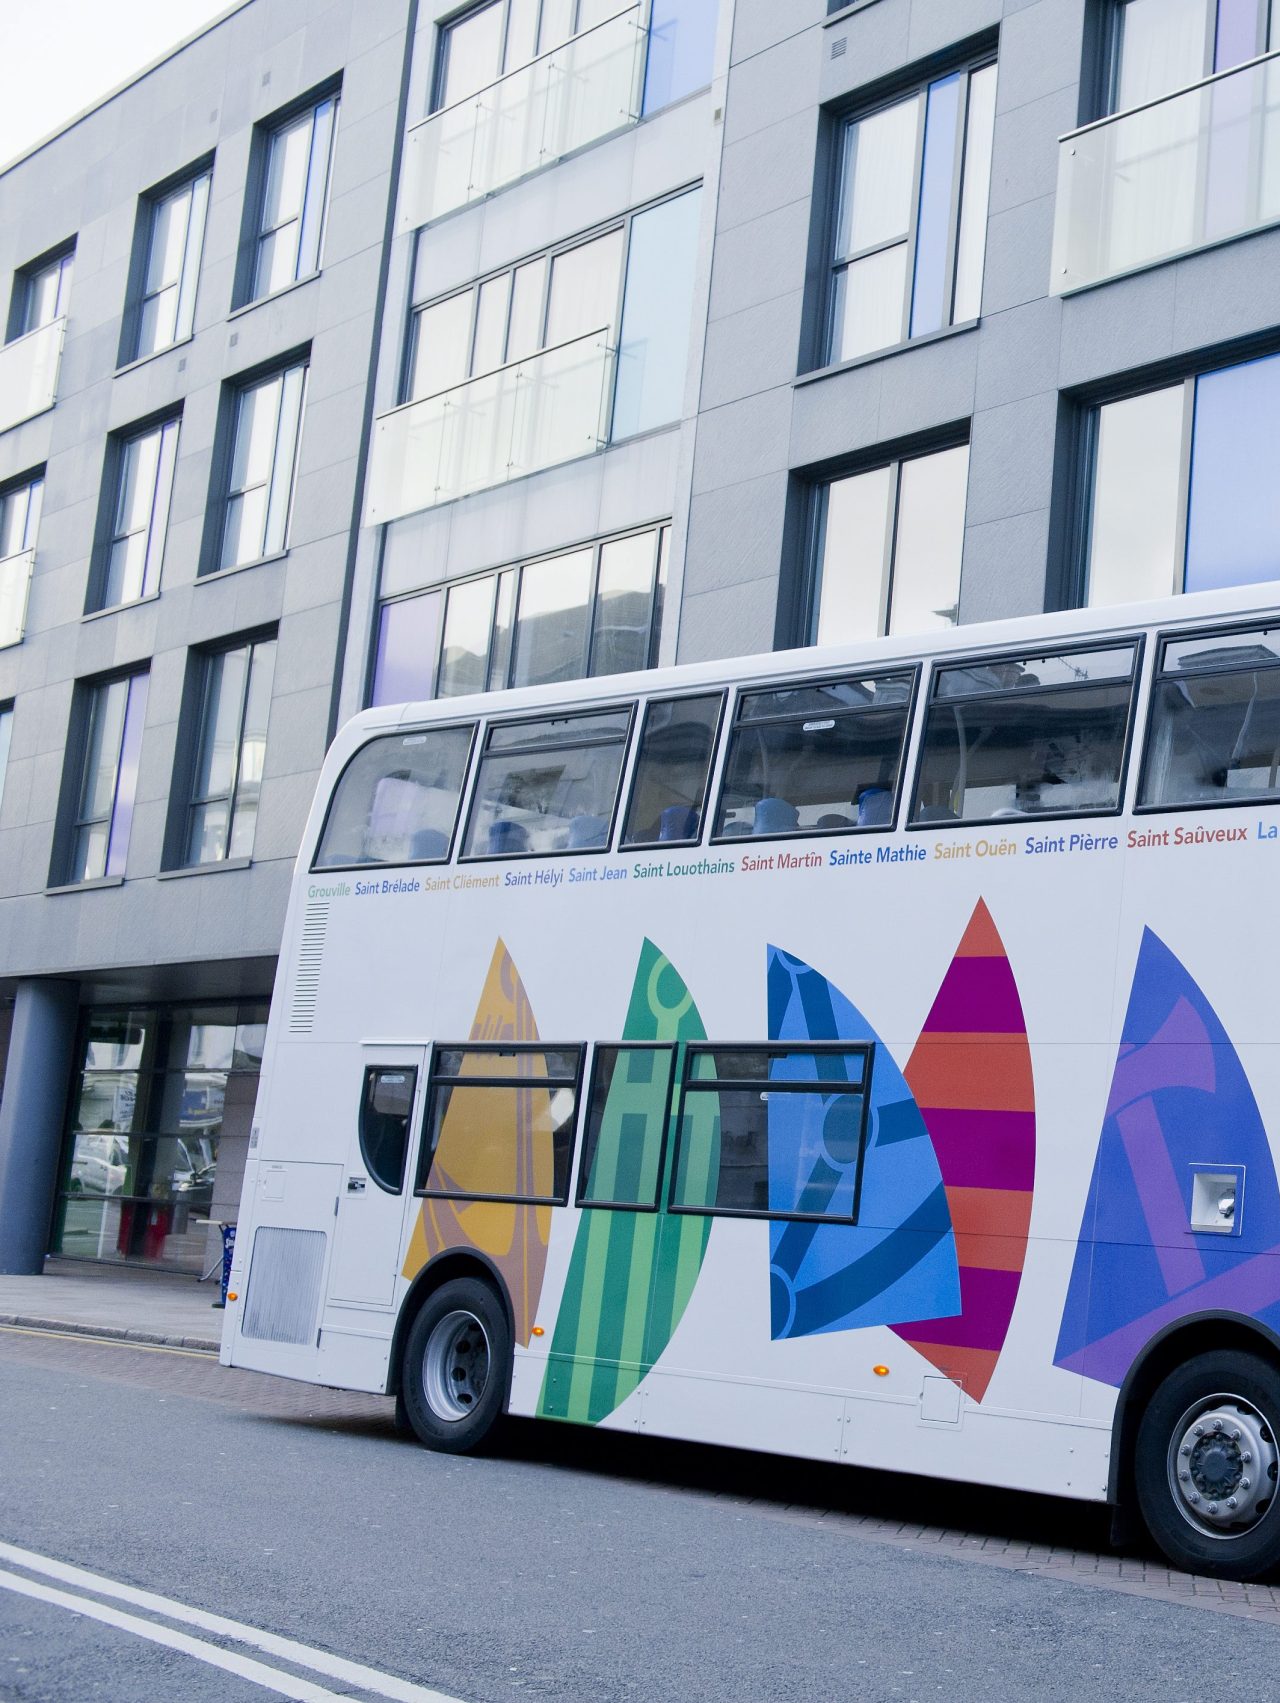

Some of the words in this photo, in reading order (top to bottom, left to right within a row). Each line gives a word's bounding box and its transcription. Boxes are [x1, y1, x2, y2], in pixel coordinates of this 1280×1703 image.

[308, 882, 350, 898] Grouville
[355, 881, 379, 896] Saint
[381, 878, 420, 894] Brélade
[425, 877, 450, 891] Saint
[504, 872, 532, 886] Saint
[534, 869, 563, 887] Hélyi
[568, 867, 597, 882] Saint
[600, 866, 627, 880] Jean
[633, 863, 663, 879] Saint
[667, 858, 734, 877] Louothains
[741, 855, 774, 871] Saint
[829, 849, 872, 866] Sainte
[876, 844, 926, 863] Mathie
[934, 841, 972, 860] Saint
[975, 839, 1017, 858] Ouën
[1025, 836, 1065, 854] Saint
[1069, 833, 1118, 852] Pièrre
[1127, 829, 1169, 848] Saint
[1173, 825, 1248, 846] Saûveux
[1257, 821, 1277, 840] La
